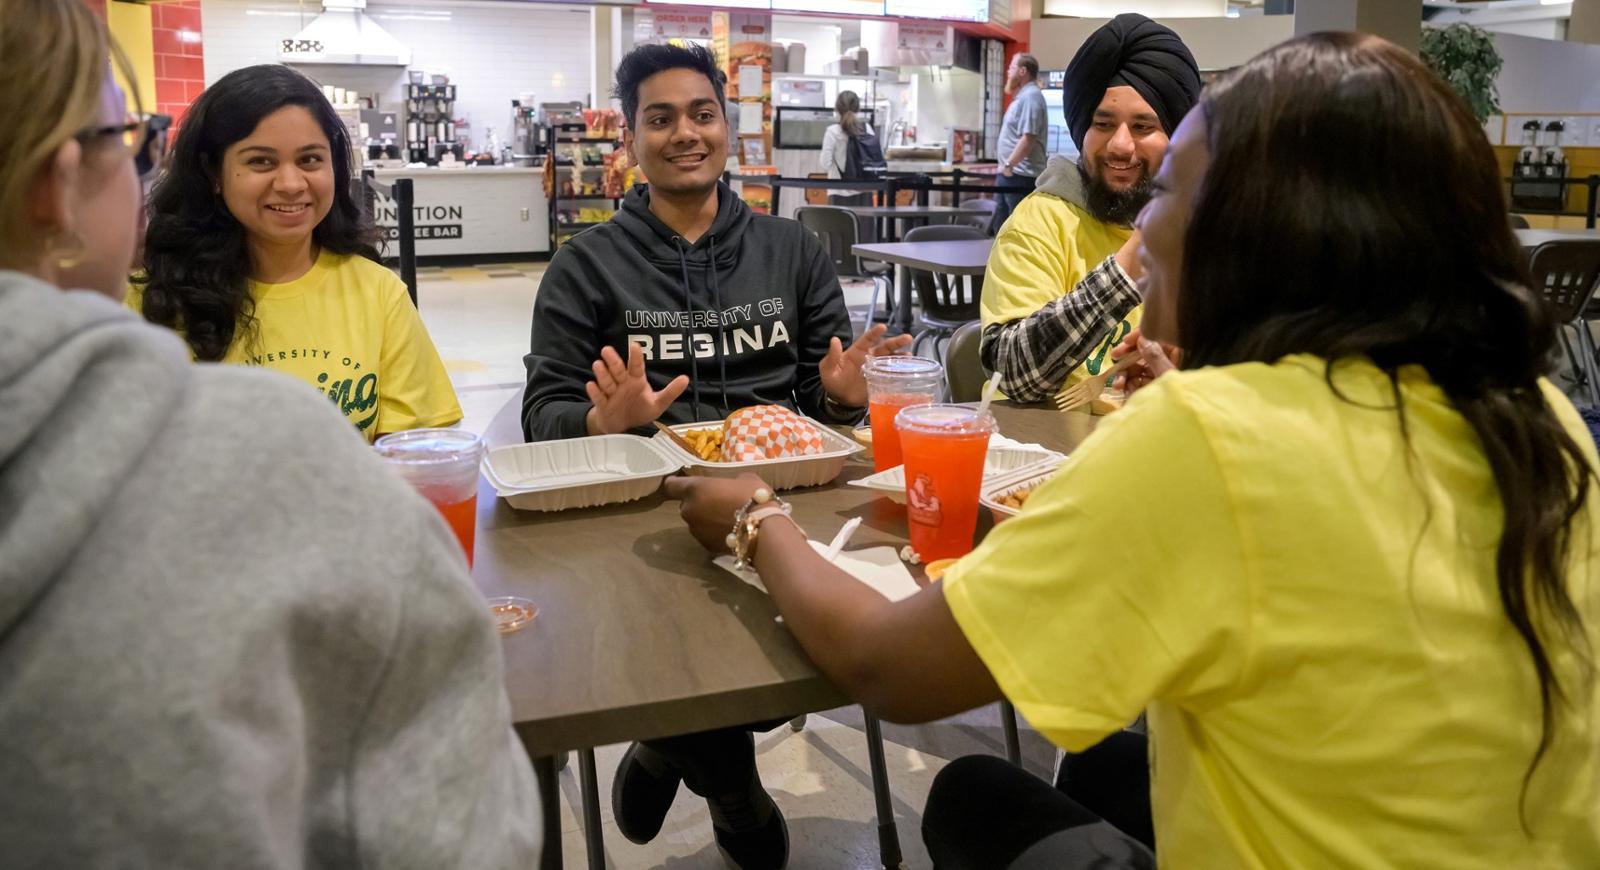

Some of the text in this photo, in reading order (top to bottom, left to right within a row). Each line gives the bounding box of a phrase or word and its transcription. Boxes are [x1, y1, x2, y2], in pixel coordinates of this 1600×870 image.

[655, 14, 709, 24] ORDER HERE
[374, 206, 462, 221] UNTION
[433, 227, 458, 237] BAR
[625, 297, 785, 329] UNIVERSITY OF
[627, 320, 790, 361] REGINA
[342, 357, 361, 370] OF
